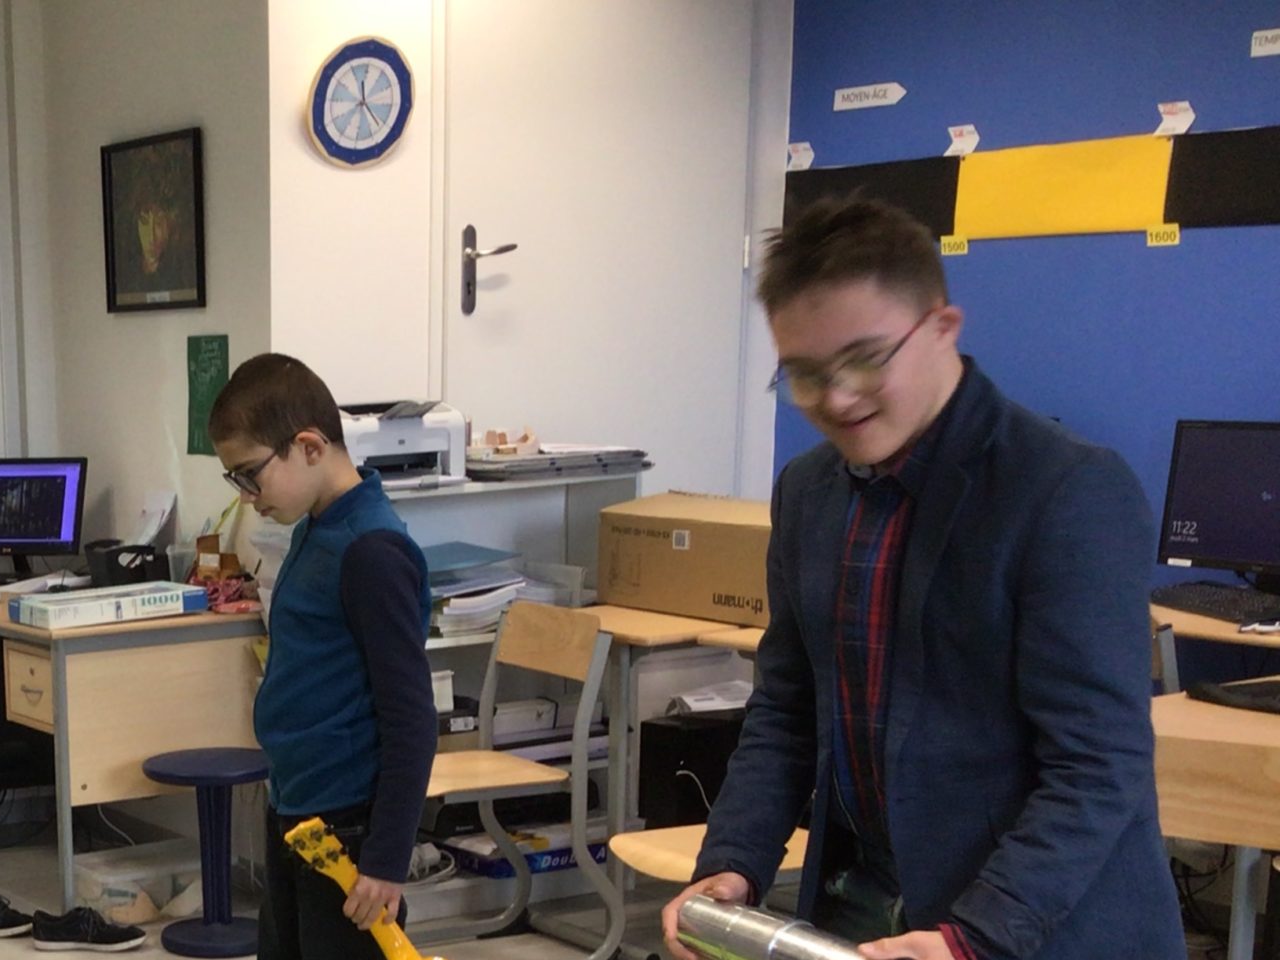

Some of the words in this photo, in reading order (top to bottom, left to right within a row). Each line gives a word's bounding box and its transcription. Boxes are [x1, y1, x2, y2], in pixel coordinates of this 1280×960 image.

[1148, 230, 1177, 243] 1600
[942, 241, 966, 253] 1500
[1172, 520, 1198, 535] 11:22
[140, 593, 180, 607] 1000
